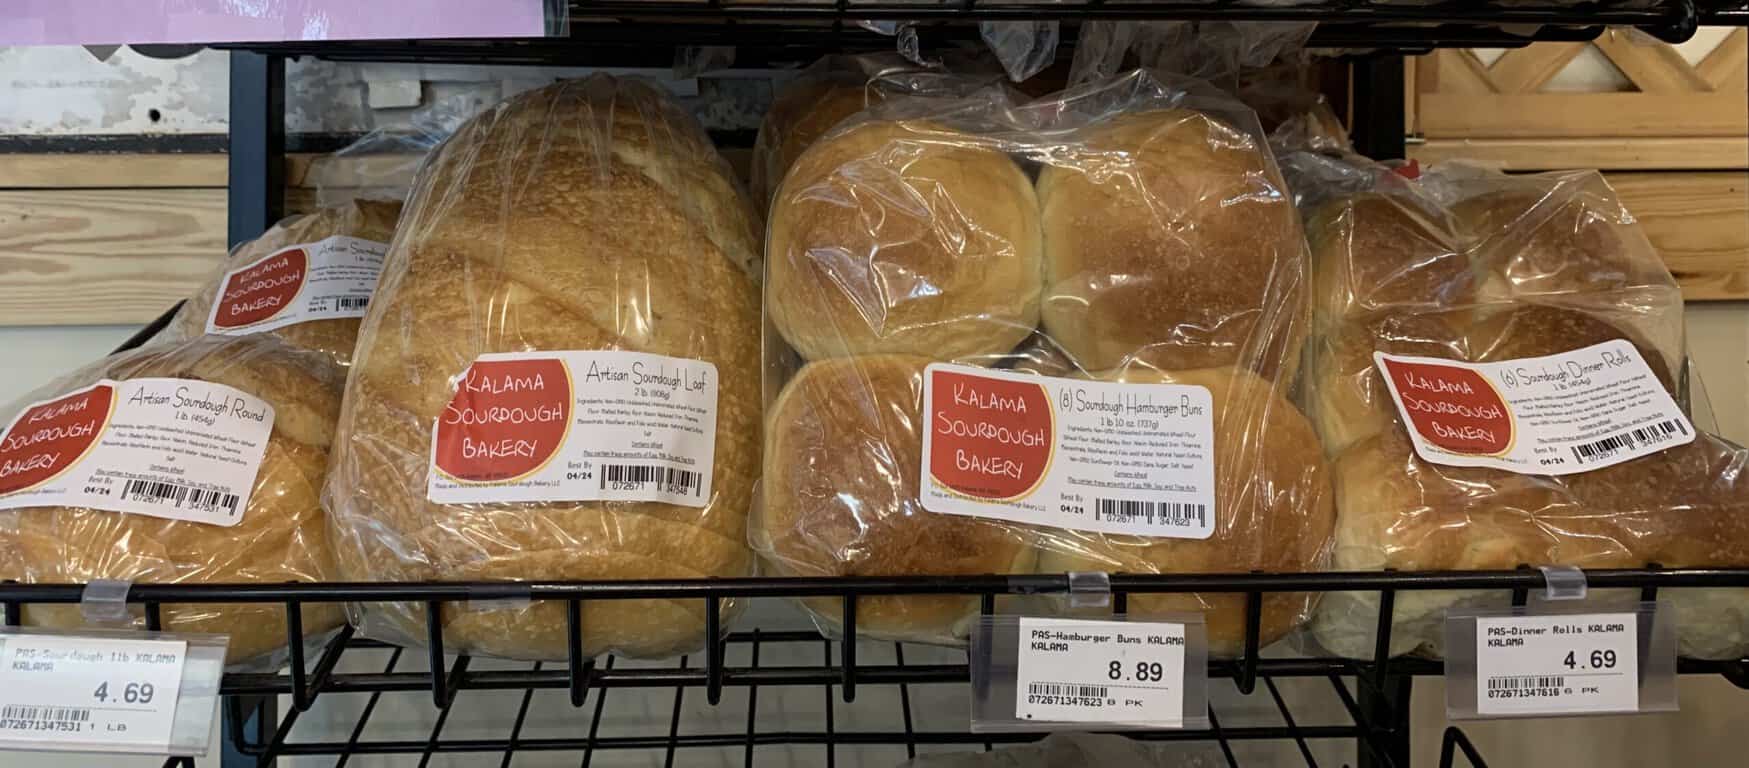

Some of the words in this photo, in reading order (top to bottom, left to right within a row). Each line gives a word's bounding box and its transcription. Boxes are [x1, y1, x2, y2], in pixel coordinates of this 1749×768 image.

[240, 257, 289, 284] KALAMA
[231, 294, 282, 316] BAKERY
[586, 360, 628, 383] Artisan
[632, 361, 681, 390] Sourdough
[685, 368, 706, 393] Loaf
[1516, 364, 1569, 385] Sourdough
[1566, 360, 1604, 379] Dinner
[1601, 349, 1632, 368] Rolls
[465, 371, 545, 395] KALAMA
[1404, 372, 1474, 395] KALAMA
[128, 385, 170, 405] Artisan
[173, 386, 228, 416] Sourdough
[230, 398, 266, 422] Round
[953, 384, 1027, 413] KALAMA
[1060, 388, 1073, 412] (8)
[1076, 389, 1124, 416] Sourdough
[1127, 393, 1178, 418] Hamburger
[1181, 394, 1203, 417] Buns
[1401, 393, 1504, 420] SOURDOUGH
[28, 397, 89, 424] KALAMA
[446, 400, 563, 425] SOURDOUGH
[937, 412, 1045, 447] SOURDOUGH
[1115, 418, 1124, 427] 10
[1431, 421, 1497, 444] BAKERY
[1, 419, 95, 452] SOURDOUGH
[462, 437, 538, 459] BAKERY
[0, 452, 61, 478] BAKERY
[956, 449, 1024, 479] BAKERY
[567, 472, 592, 480] 04/24
[612, 481, 645, 491] 072671
[1060, 504, 1084, 514] 04/24
[1031, 630, 1111, 643] PAS-Hamburger
[1117, 634, 1142, 644] Buns
[1147, 636, 1184, 645] KALAMA
[1488, 626, 1547, 636] PAS-Dinner
[1553, 625, 1582, 634] Rolls
[1588, 624, 1624, 633] KALAMA
[1031, 642, 1068, 652] KALAMA
[1488, 638, 1524, 647] KALAMA
[12, 661, 54, 671] KALAMA
[135, 653, 176, 664] KALAMA
[1564, 650, 1617, 669] 4.69
[1108, 661, 1163, 682] 8.89
[94, 681, 154, 703] 4.69
[1028, 695, 1102, 706] 072671347623
[1488, 689, 1560, 699] 072671347616
[0, 719, 81, 731] 072671347531
